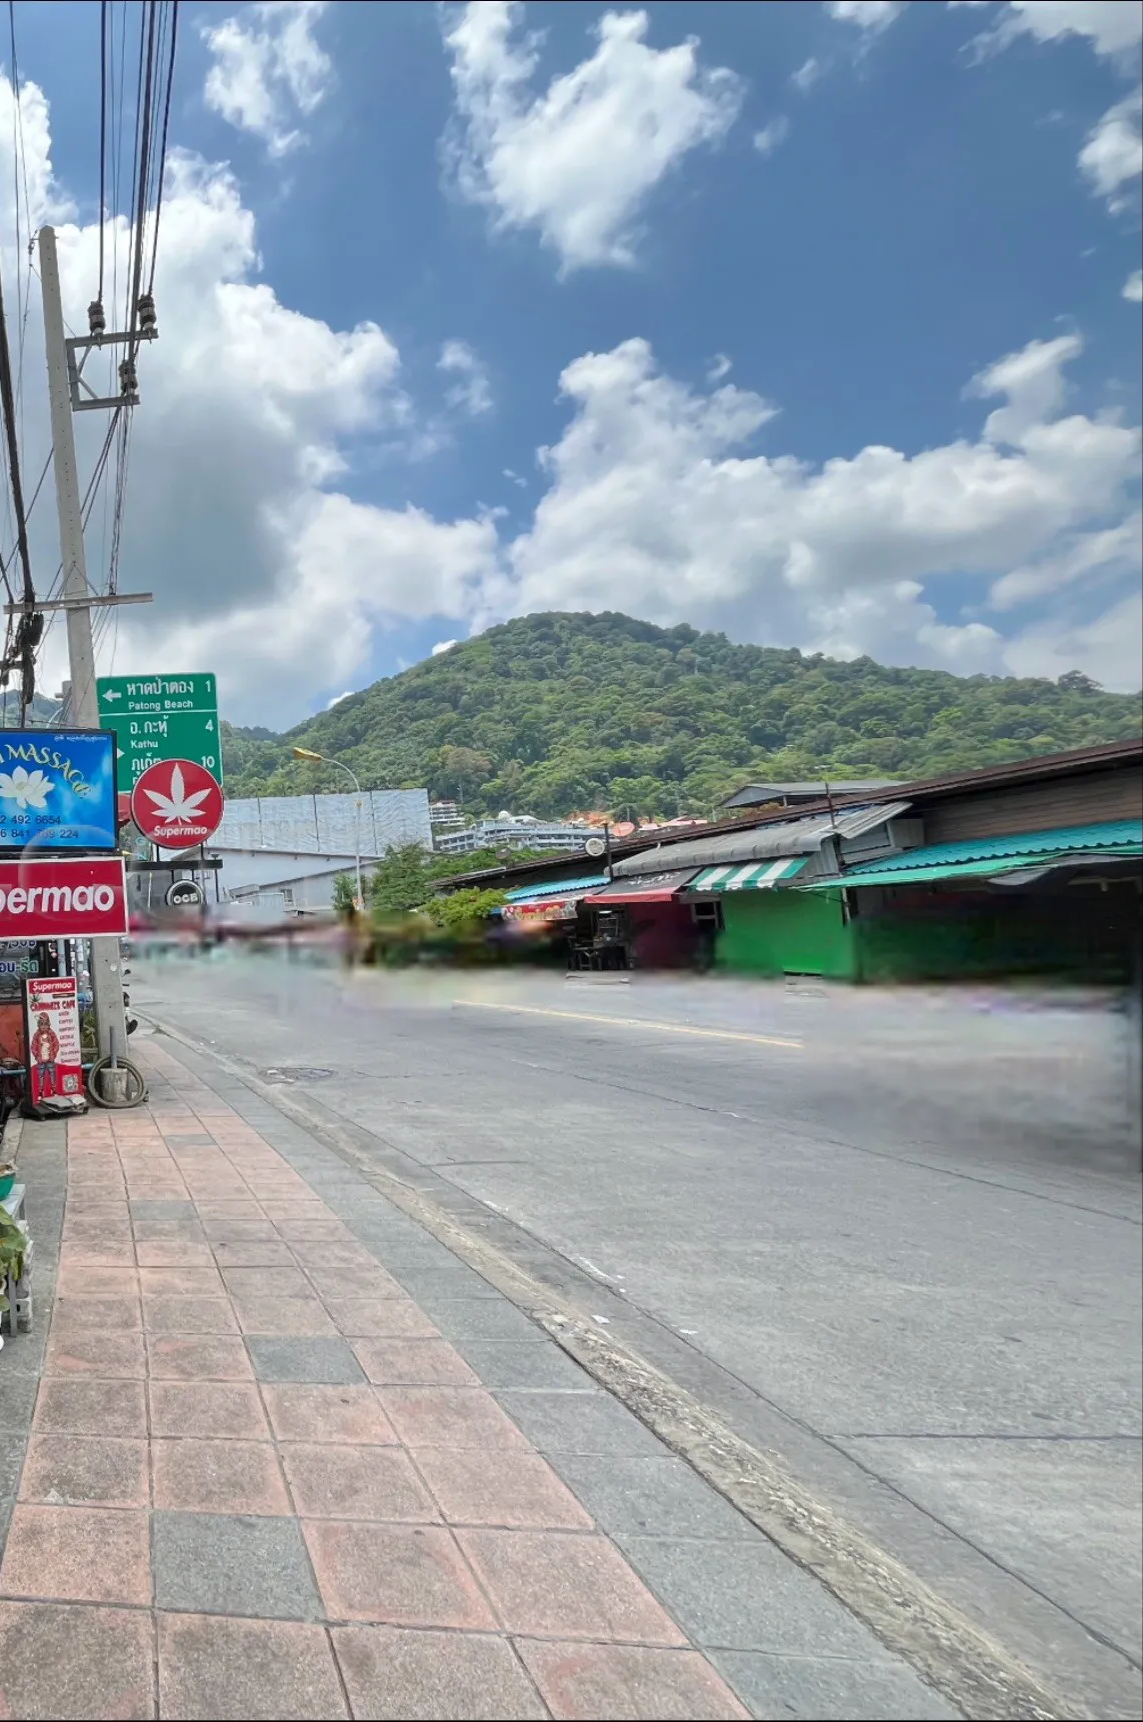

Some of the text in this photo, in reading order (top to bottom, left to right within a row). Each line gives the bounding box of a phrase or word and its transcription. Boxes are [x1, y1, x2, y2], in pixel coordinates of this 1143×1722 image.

[127, 677, 211, 696] หาดป่าตอง 1
[128, 699, 193, 711] Patong Beach
[205, 719, 214, 732] 4
[130, 740, 158, 748] Kathu
[201, 756, 215, 768] 10
[11, 815, 31, 824] 492
[60, 829, 79, 839] 224
[153, 825, 207, 838] Supermao
[173, 893, 198, 904] OCB
[33, 981, 72, 992] Supermao
